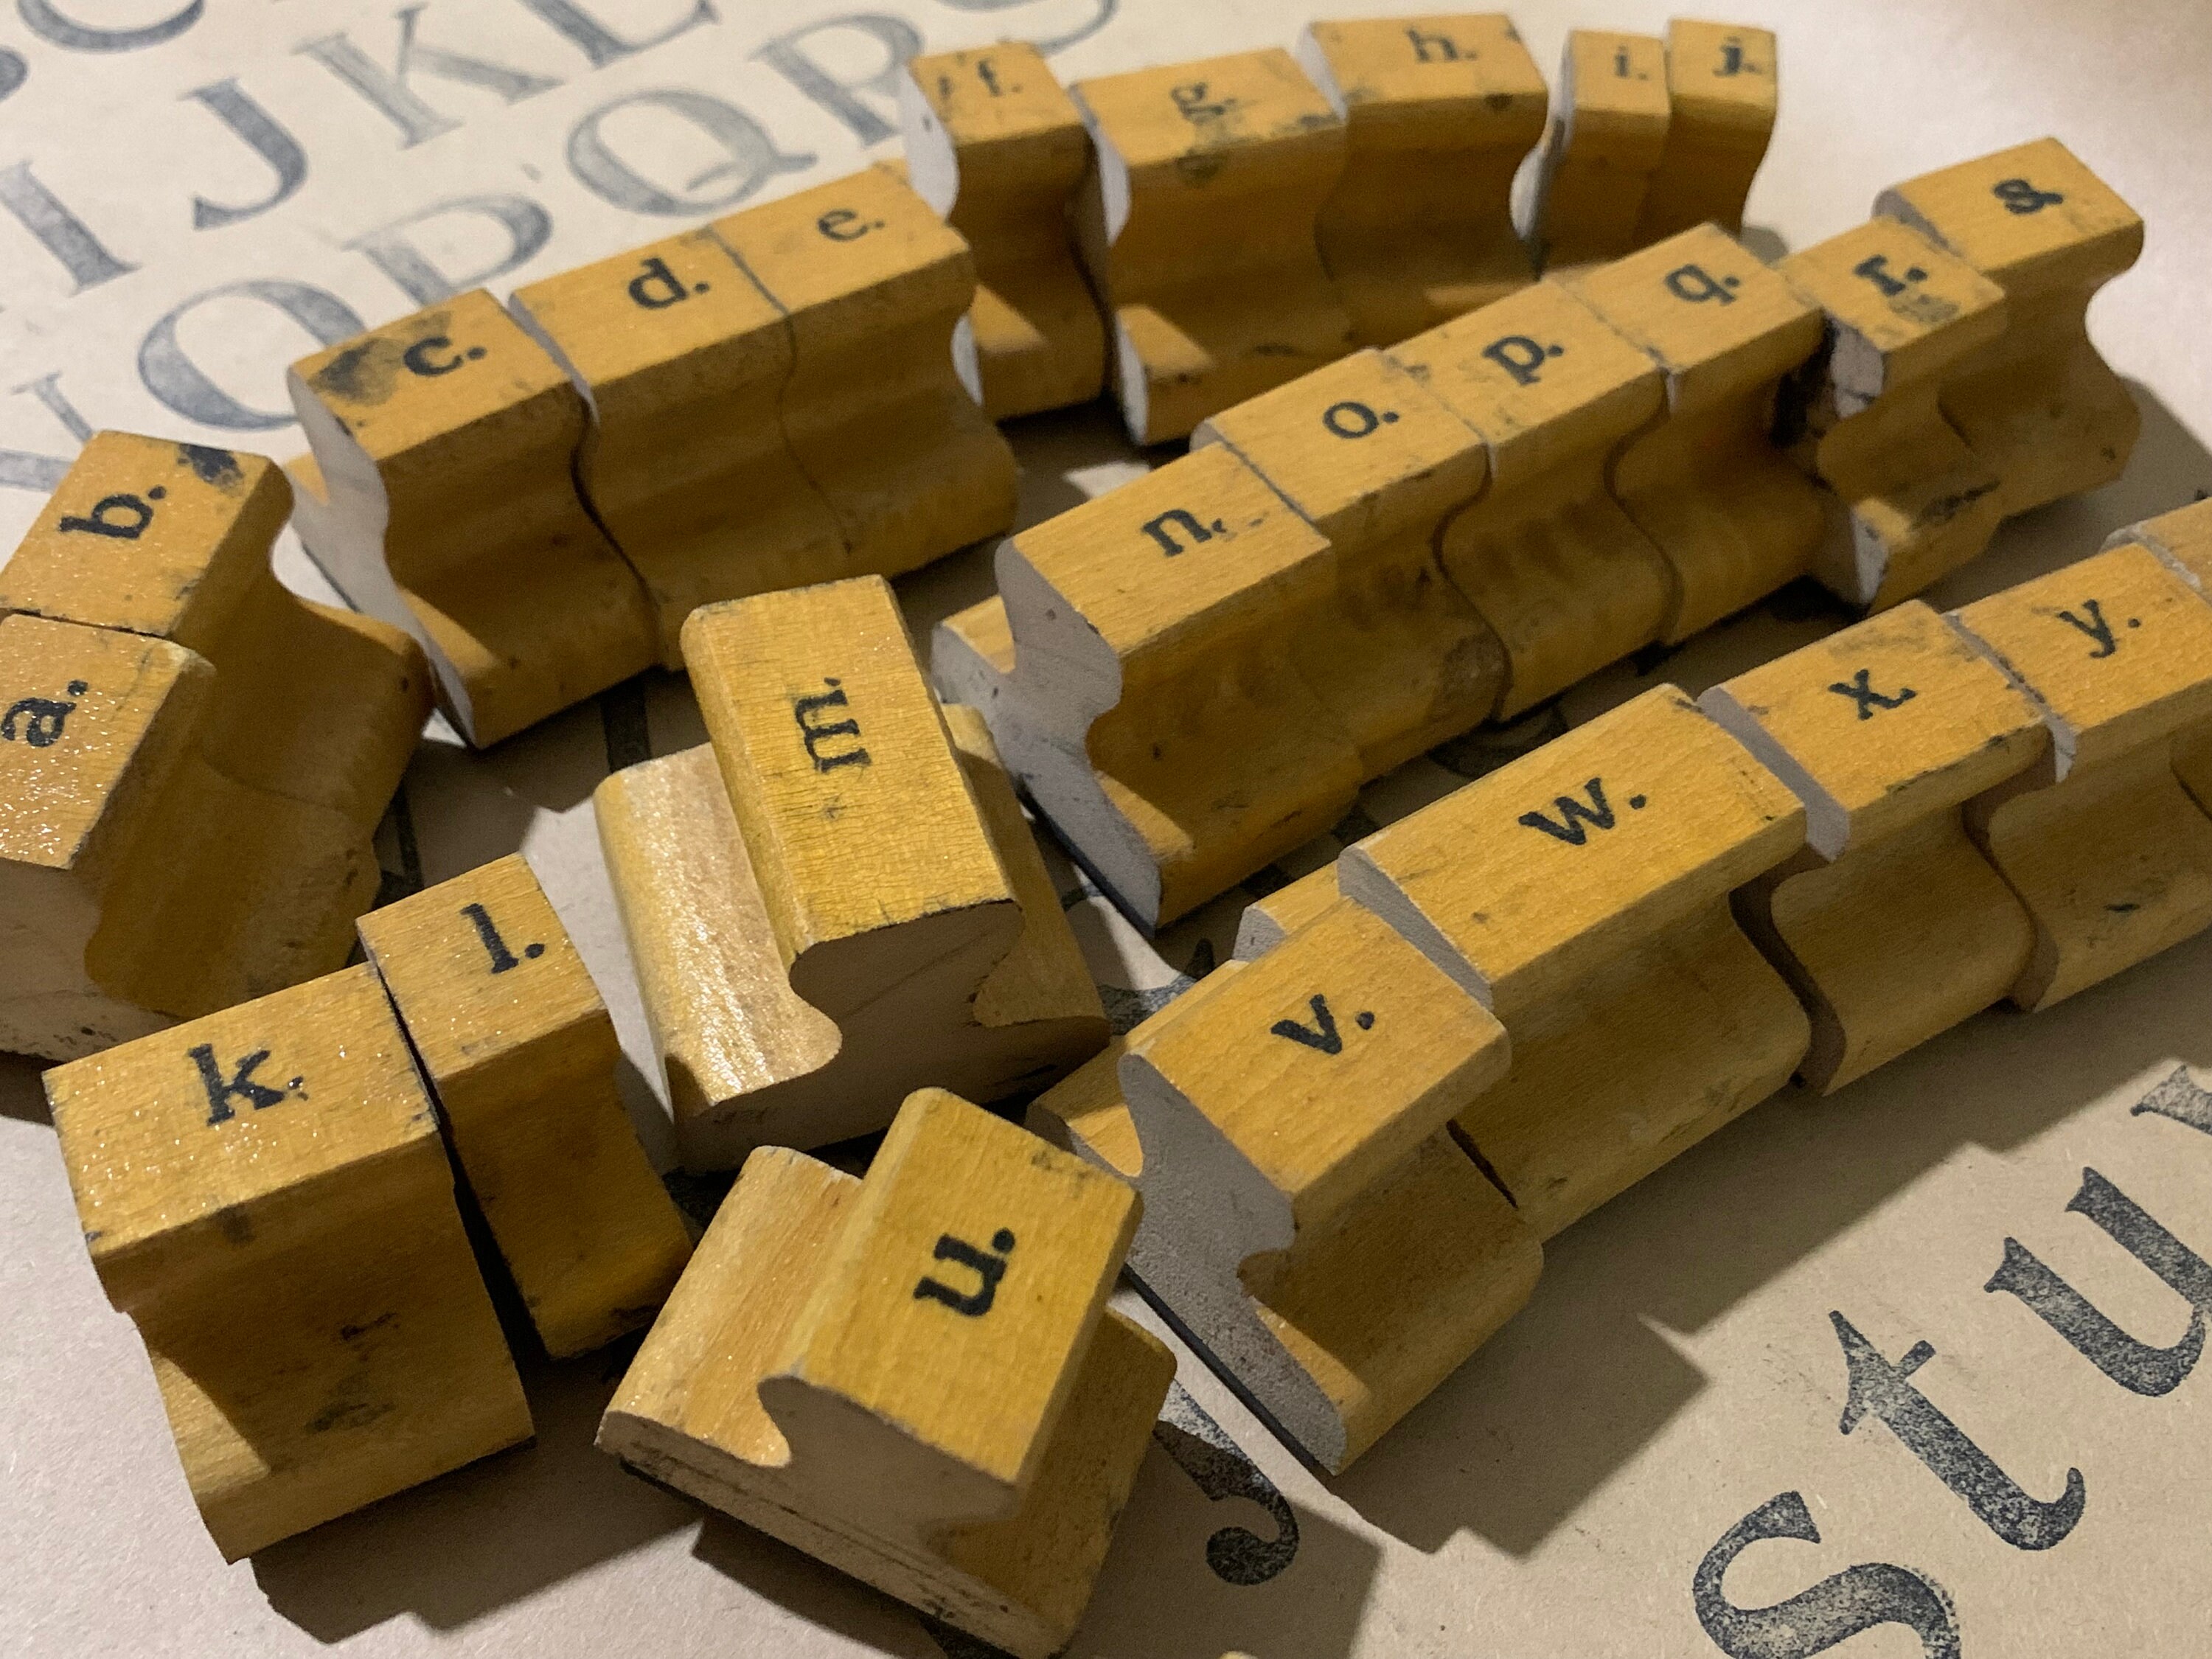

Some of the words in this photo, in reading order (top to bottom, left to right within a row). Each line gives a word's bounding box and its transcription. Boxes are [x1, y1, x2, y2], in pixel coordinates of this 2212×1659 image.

[1405, 26, 1479, 63] h.
[175, 77, 310, 230] J
[293, 2, 566, 150] K
[565, 88, 818, 216] Q
[818, 208, 886, 242] e.
[627, 257, 710, 310] d.
[1664, 262, 1742, 307] q.
[1854, 254, 1929, 296] r.
[403, 336, 487, 378] c.
[1483, 335, 1565, 386] p.
[1323, 401, 1400, 439] o.
[59, 484, 167, 540] b.
[2059, 599, 2141, 658] y.
[0, 680, 88, 748] a.
[1828, 669, 1917, 721] x.
[1519, 777, 1648, 846] w.
[461, 902, 546, 975] l.
[1270, 993, 1376, 1056] v.
[912, 1227, 1016, 1318] u.
[1827, 1310, 2086, 1551] t
